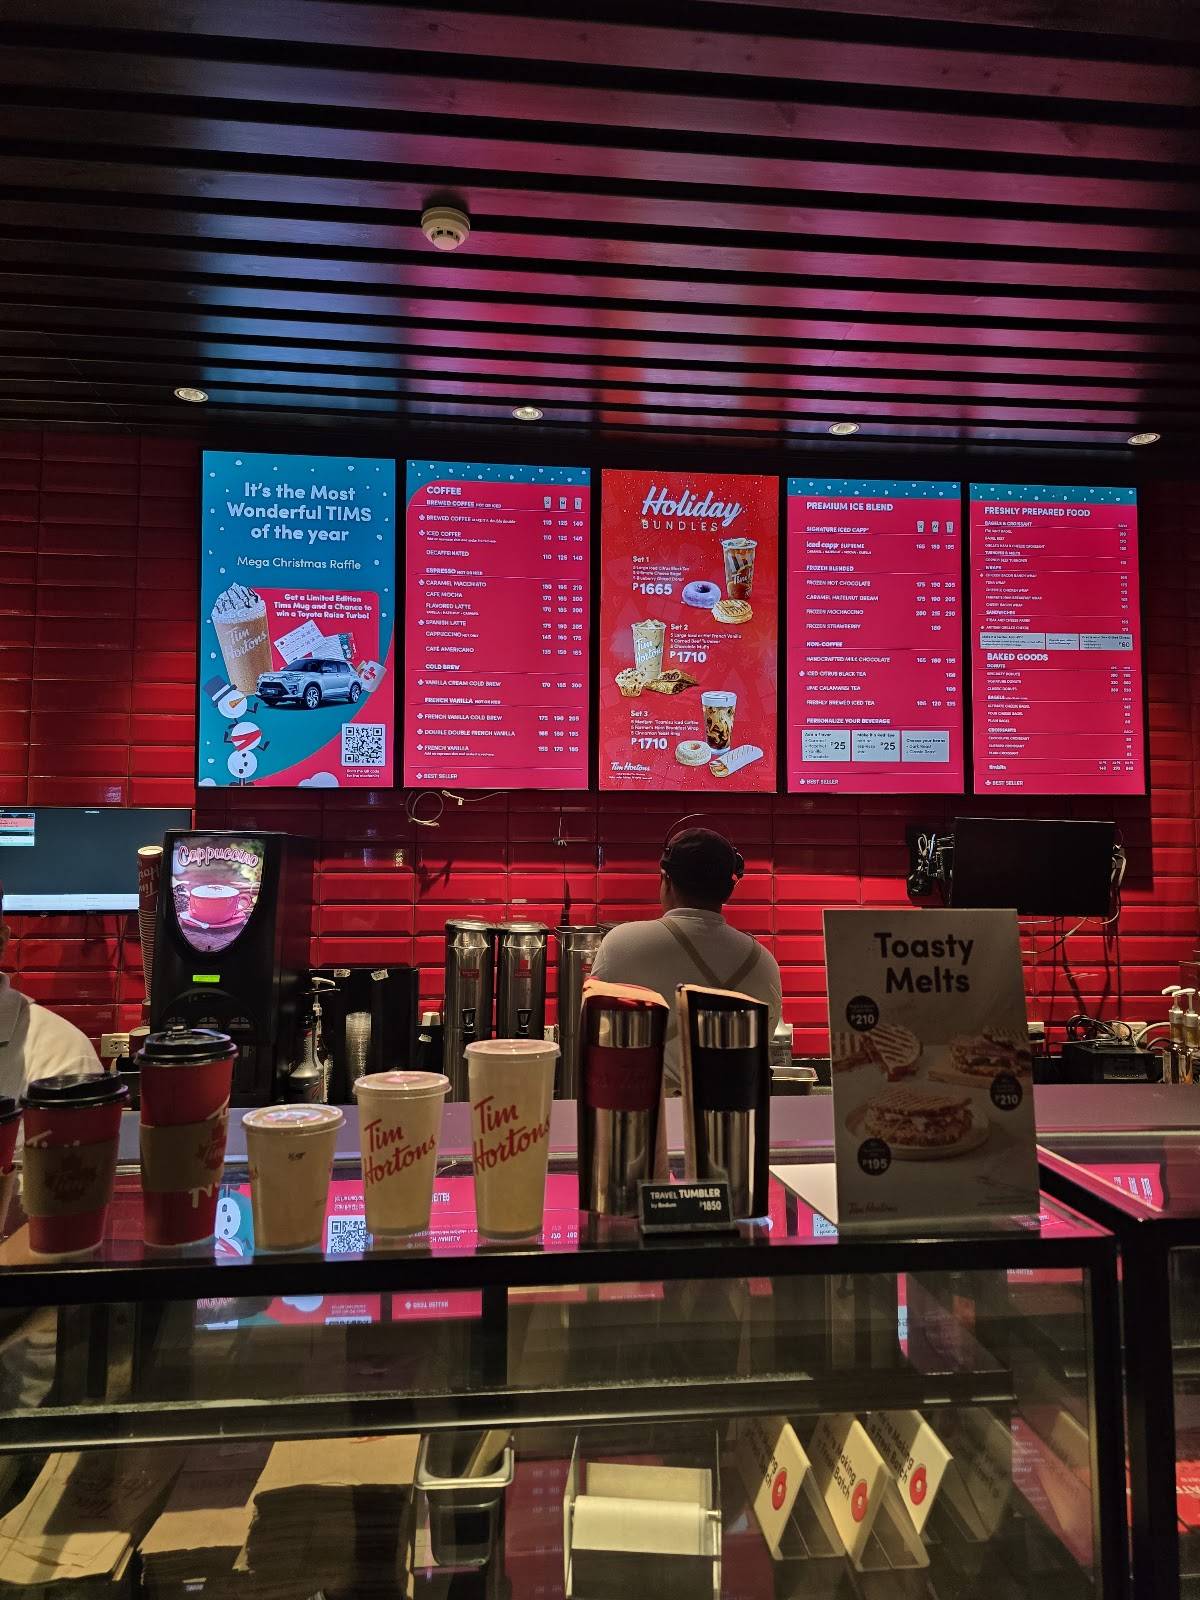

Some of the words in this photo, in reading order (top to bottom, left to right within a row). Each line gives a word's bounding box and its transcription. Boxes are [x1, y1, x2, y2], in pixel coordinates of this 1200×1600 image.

[244, 482, 271, 498] It's
[275, 483, 306, 499] the
[310, 485, 356, 501] Most
[426, 486, 462, 496] COFFEE
[226, 501, 322, 520] Wonderful
[325, 505, 372, 522] TIMS
[641, 485, 743, 527] Holiday
[806, 501, 848, 511] PREMIUM
[849, 502, 864, 511] ICE
[865, 503, 894, 512] BLEND
[984, 506, 1021, 516] FRESHLY
[1021, 507, 1065, 517] PREPARED
[1066, 508, 1091, 517] FOOD
[641, 519, 718, 532] BUNDLES
[250, 523, 271, 539] of
[273, 524, 304, 540] the
[307, 528, 350, 545] year
[236, 556, 270, 569] Mega
[272, 557, 327, 569] Christmas
[330, 559, 361, 570] Raffle
[632, 555, 645, 563] Set
[425, 579, 453, 587] CARAMEL
[284, 593, 299, 601] Get
[306, 594, 334, 602] Limited
[335, 595, 362, 603] Edition
[273, 601, 292, 609] Tims
[292, 602, 310, 610] Mug
[311, 602, 327, 610] and
[334, 603, 363, 611] Chance
[297, 610, 323, 619] Toyota
[670, 623, 683, 631] Set
[986, 652, 1016, 661] BAKED
[1016, 653, 1049, 662] GOODS
[610, 761, 624, 771] Tim
[623, 761, 651, 771] Hortons
[178, 845, 259, 868] Cappuccino
[873, 932, 974, 966] Toasty
[885, 966, 970, 994] Melts
[474, 1095, 519, 1135] Tim
[363, 1118, 405, 1151] Tim
[472, 1114, 551, 1176] Hortons
[363, 1134, 436, 1187] Hortons
[650, 1191, 678, 1200] TRAVEL
[678, 1188, 721, 1199] TUMBLER
[833, 1465, 850, 1500] Batch
